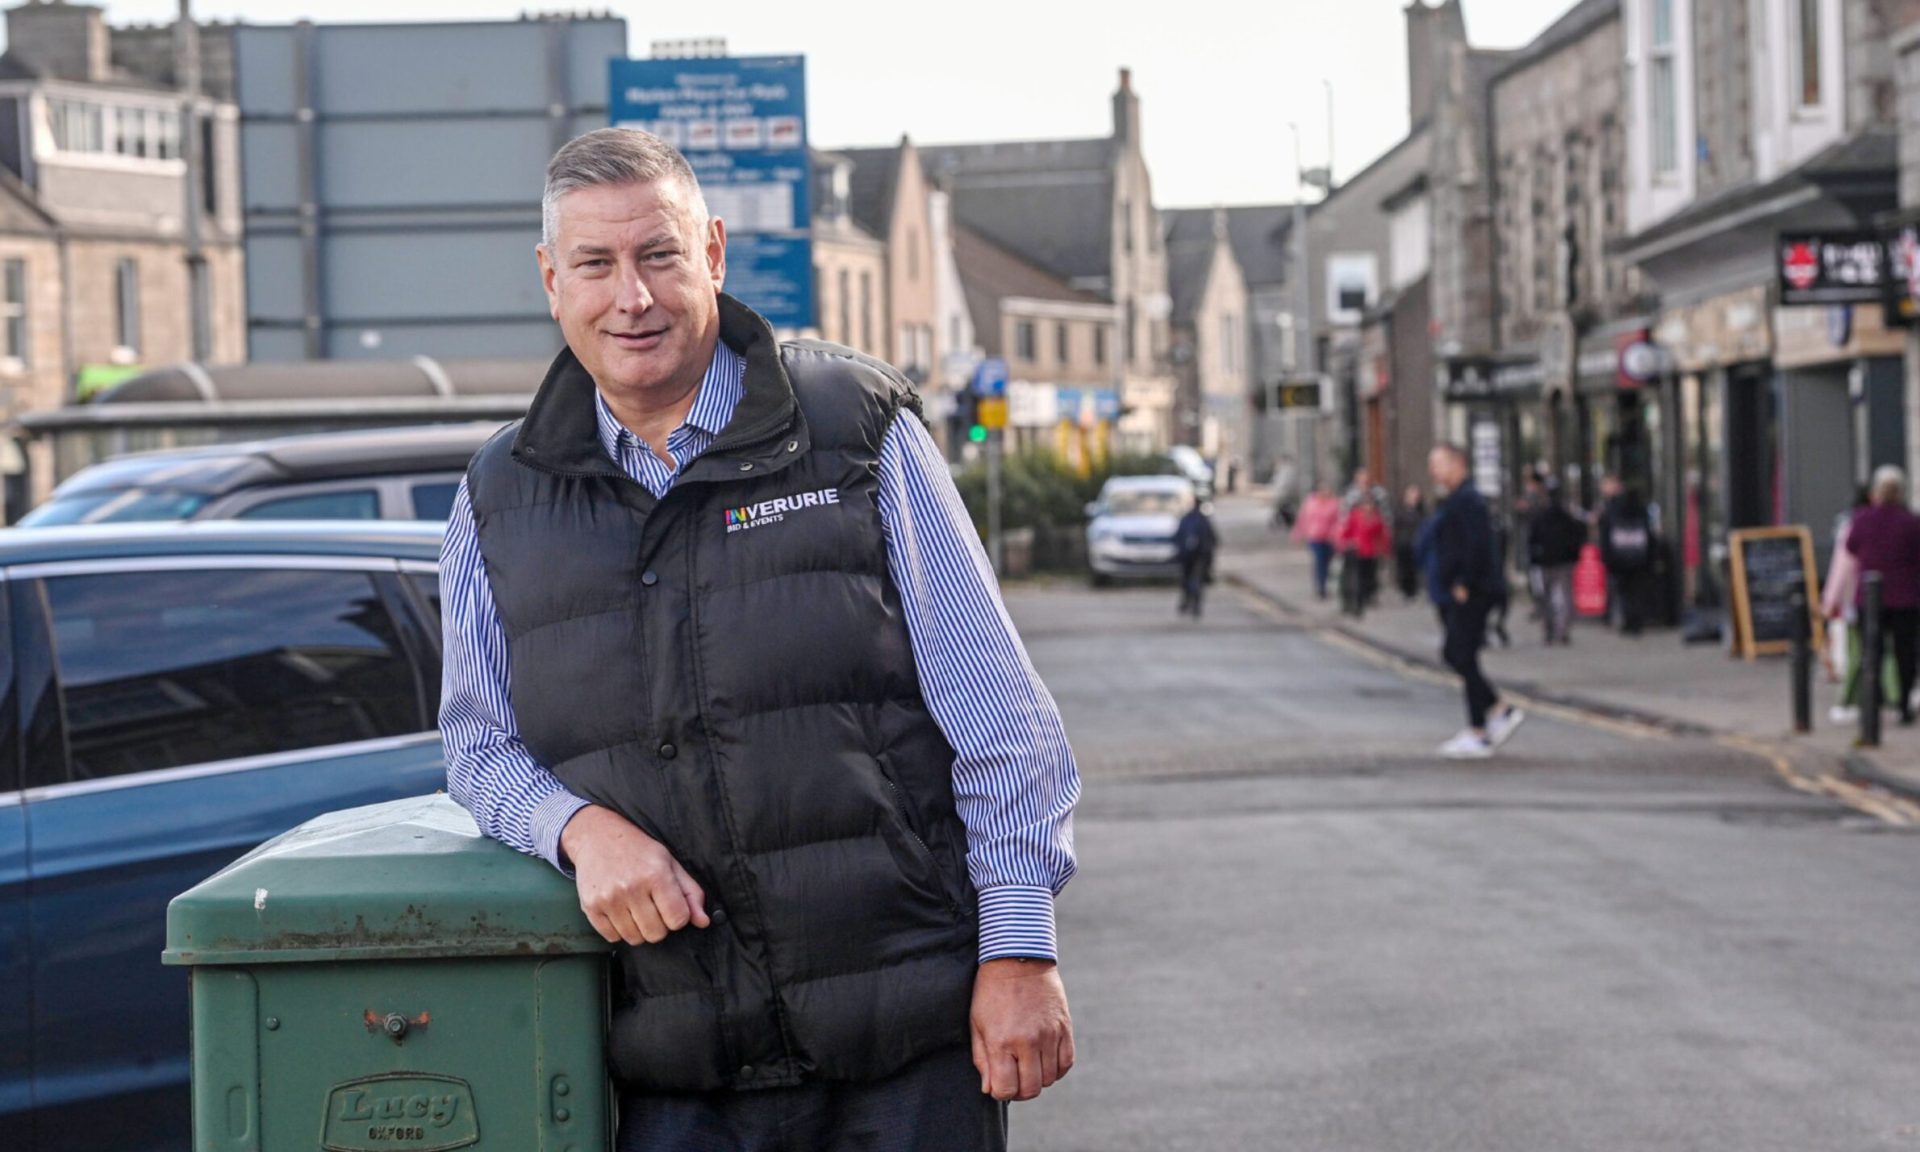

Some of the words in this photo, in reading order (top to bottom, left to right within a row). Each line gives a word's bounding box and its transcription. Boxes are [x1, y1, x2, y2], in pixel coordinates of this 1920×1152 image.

[725, 488, 839, 525] INVERURIE
[727, 524, 741, 533] BID
[750, 514, 784, 528] EVENTS
[340, 1090, 459, 1127] Lucy
[368, 1126, 425, 1140] OXFORD
